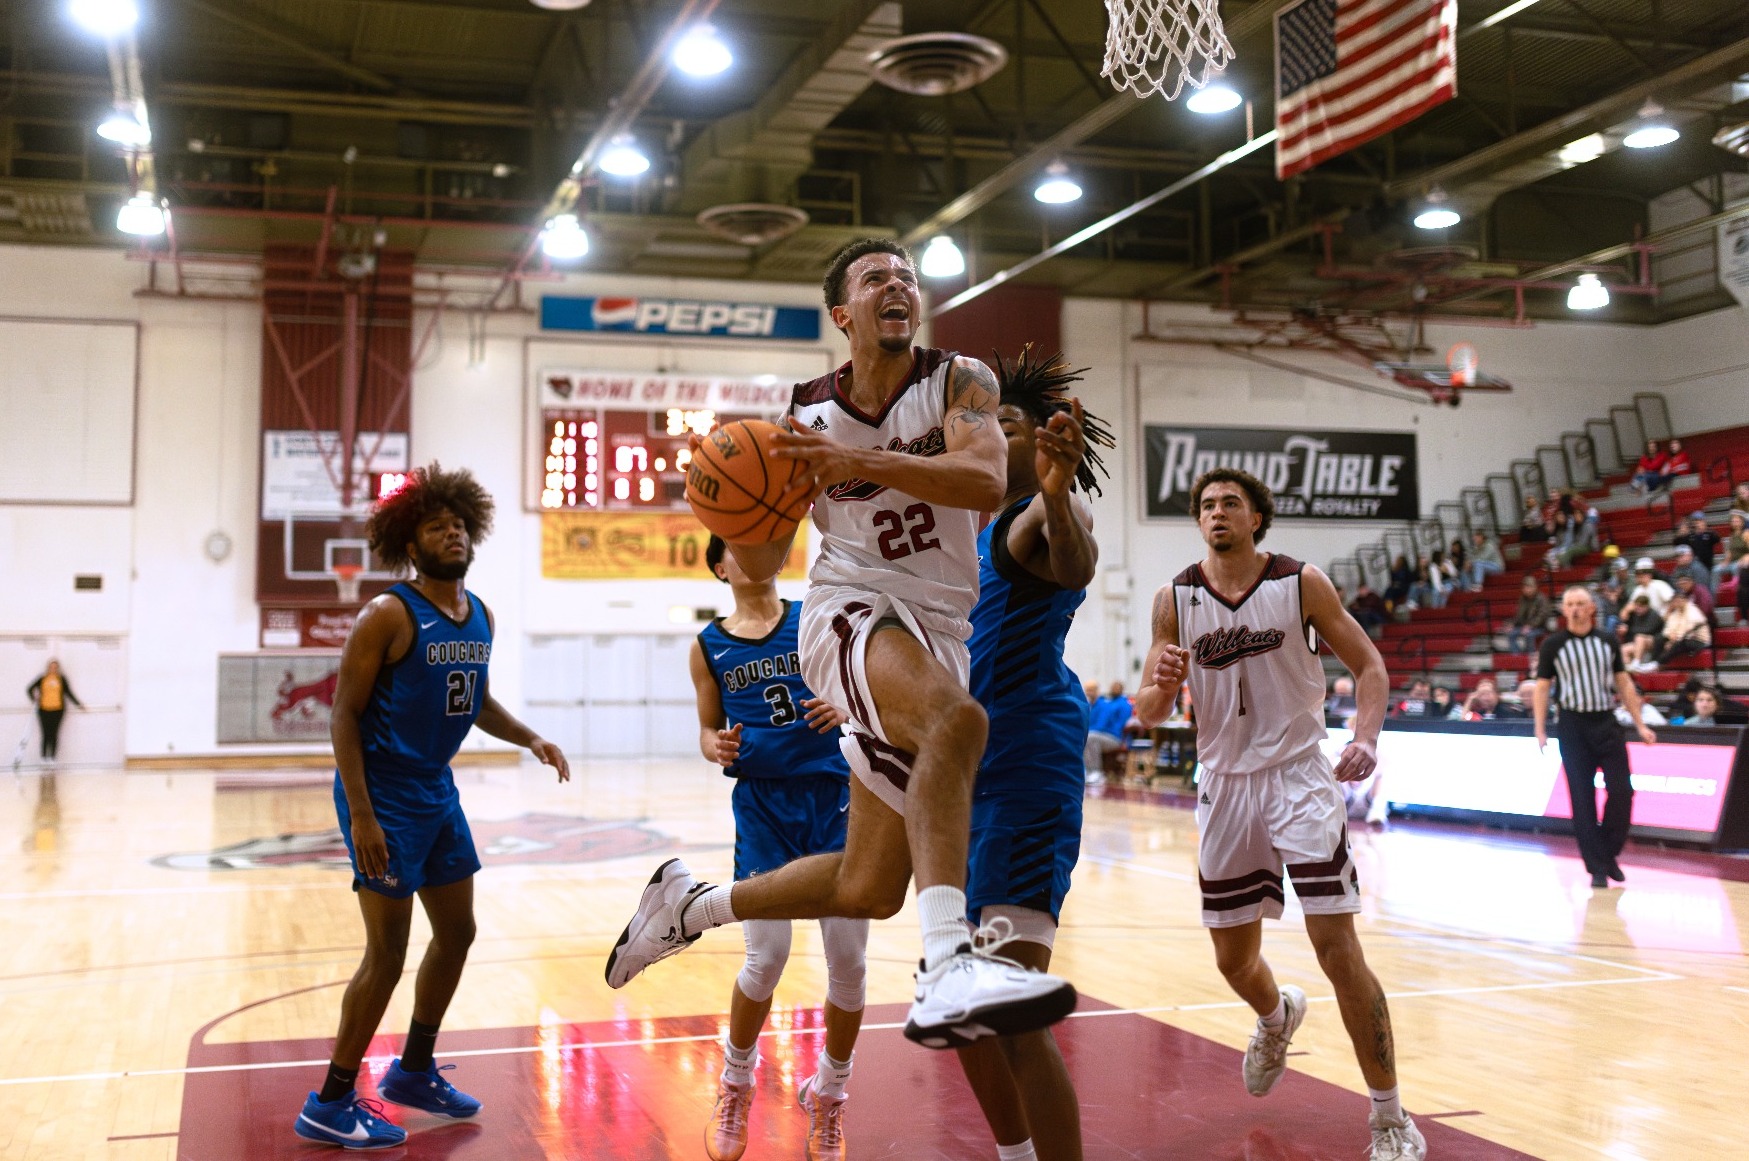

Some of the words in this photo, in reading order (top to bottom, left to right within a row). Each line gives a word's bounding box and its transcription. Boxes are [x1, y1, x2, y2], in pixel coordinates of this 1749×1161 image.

[635, 301, 776, 336] PEPSI
[577, 377, 634, 401] HOME
[642, 379, 669, 402] OF
[719, 382, 793, 405] WILDCA
[1284, 435, 1404, 501] TABLE
[1312, 498, 1381, 516] ROYALTY
[872, 502, 941, 561] 22
[426, 640, 491, 666] COUGARS
[1191, 625, 1286, 671] Wildcats
[445, 670, 477, 716] 21
[724, 651, 801, 693] COUGAR
[763, 683, 797, 727] 3
[1237, 676, 1247, 717] 1
